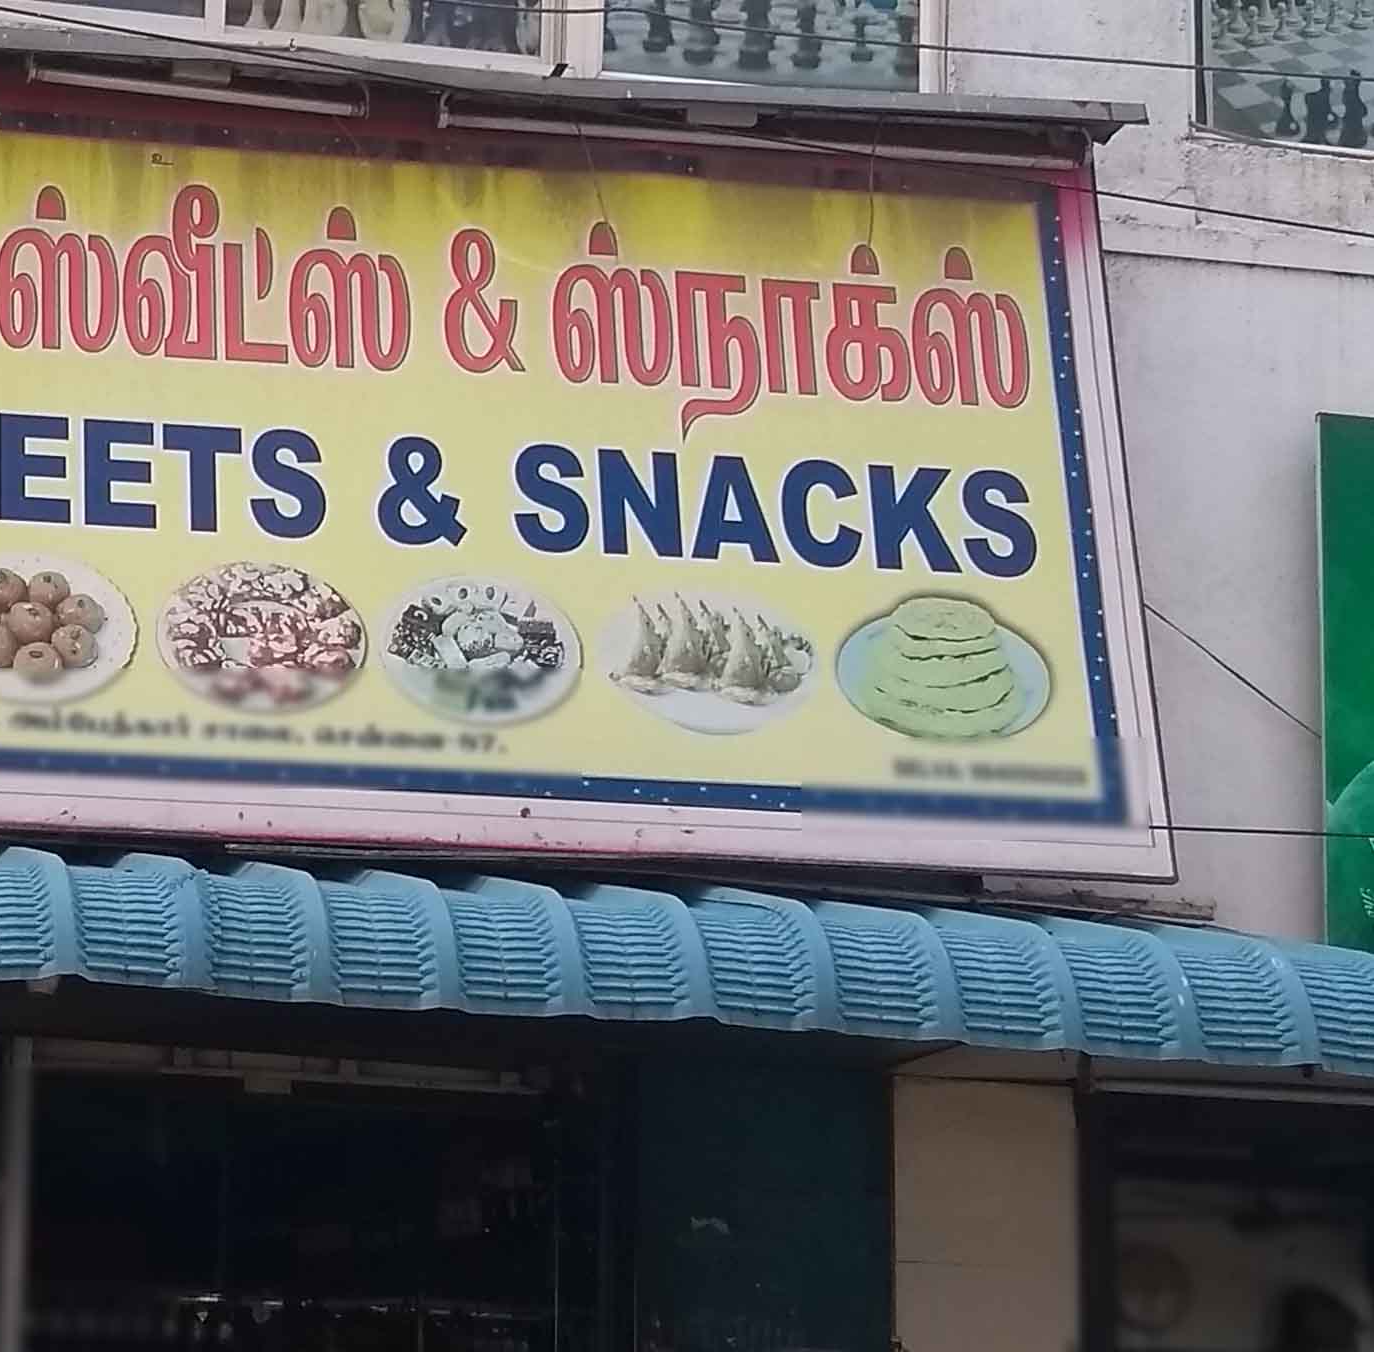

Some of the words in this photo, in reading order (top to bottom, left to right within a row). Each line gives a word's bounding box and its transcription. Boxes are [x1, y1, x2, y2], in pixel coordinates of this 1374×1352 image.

[443, 228, 525, 374] &
[552, 221, 1030, 442] ஸ்நாக்ஸ்
[378, 437, 467, 547] &
[514, 443, 1038, 577] SNACKS
